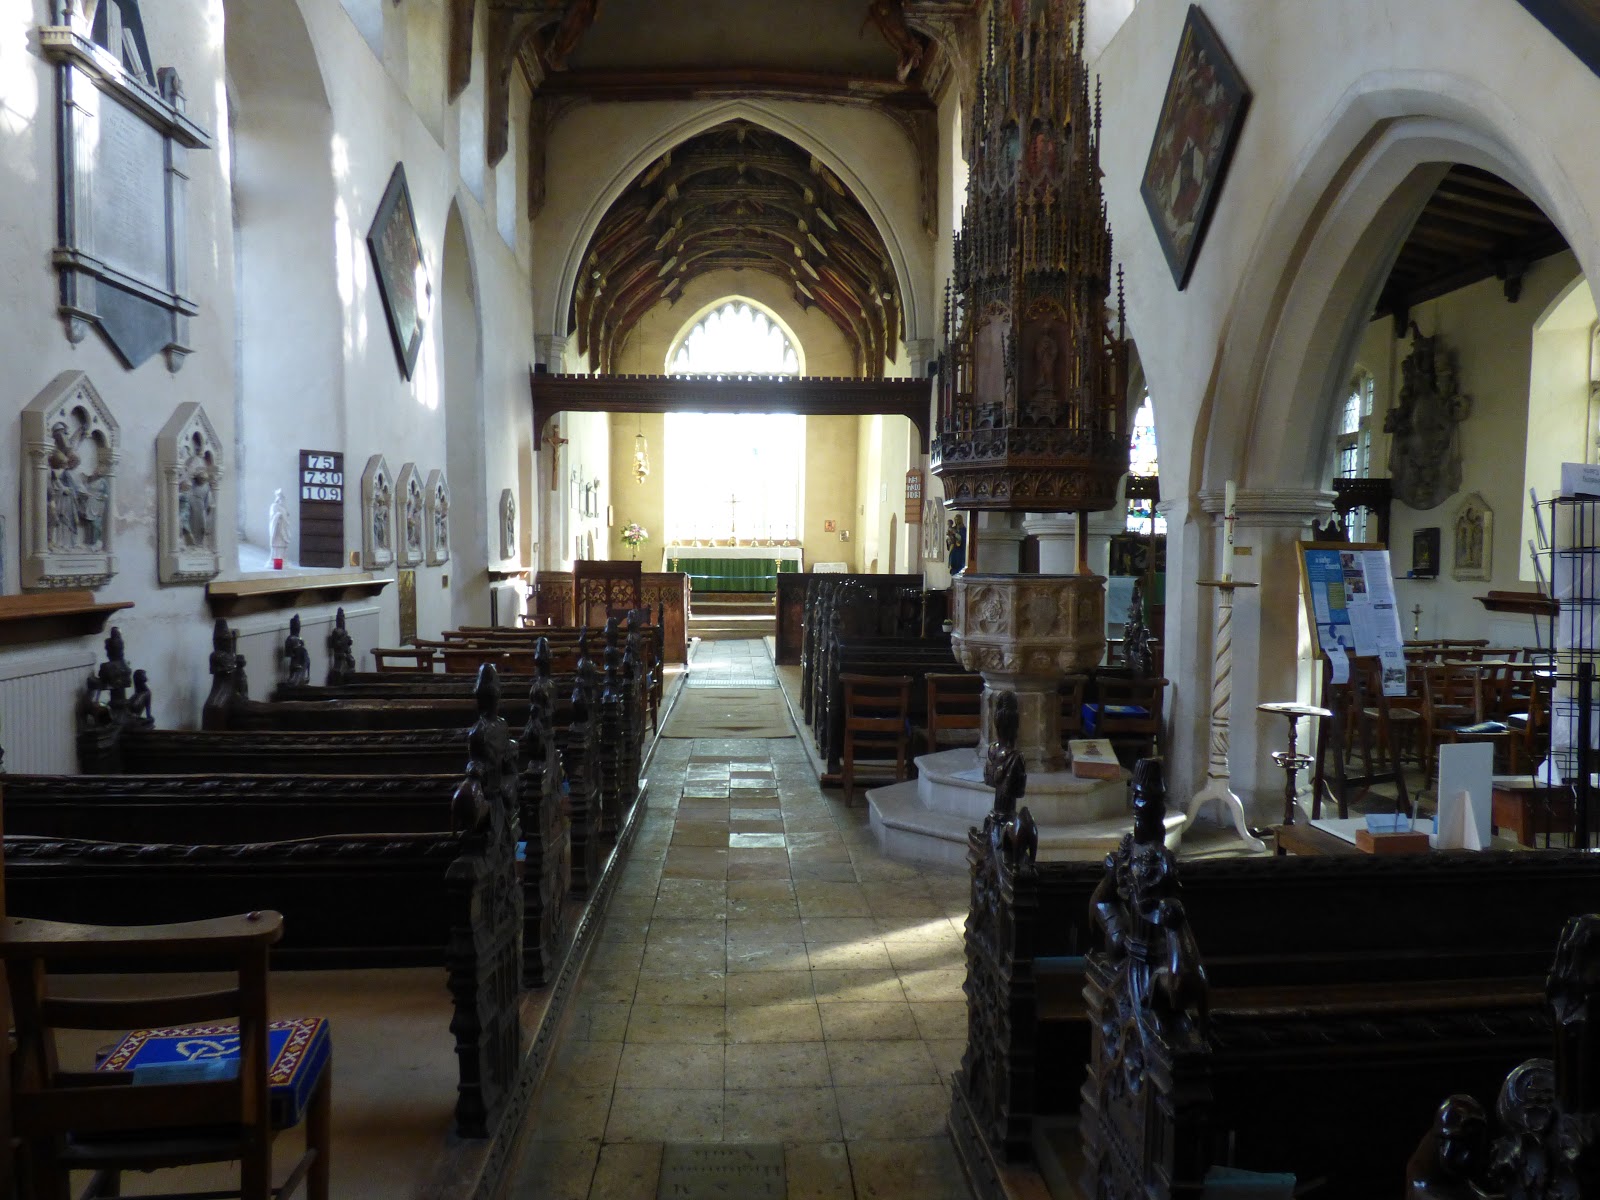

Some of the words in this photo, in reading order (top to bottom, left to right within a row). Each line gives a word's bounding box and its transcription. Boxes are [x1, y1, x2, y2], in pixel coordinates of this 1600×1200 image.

[311, 456, 332, 469] 75
[306, 471, 341, 485] 730
[306, 487, 339, 501] 109
